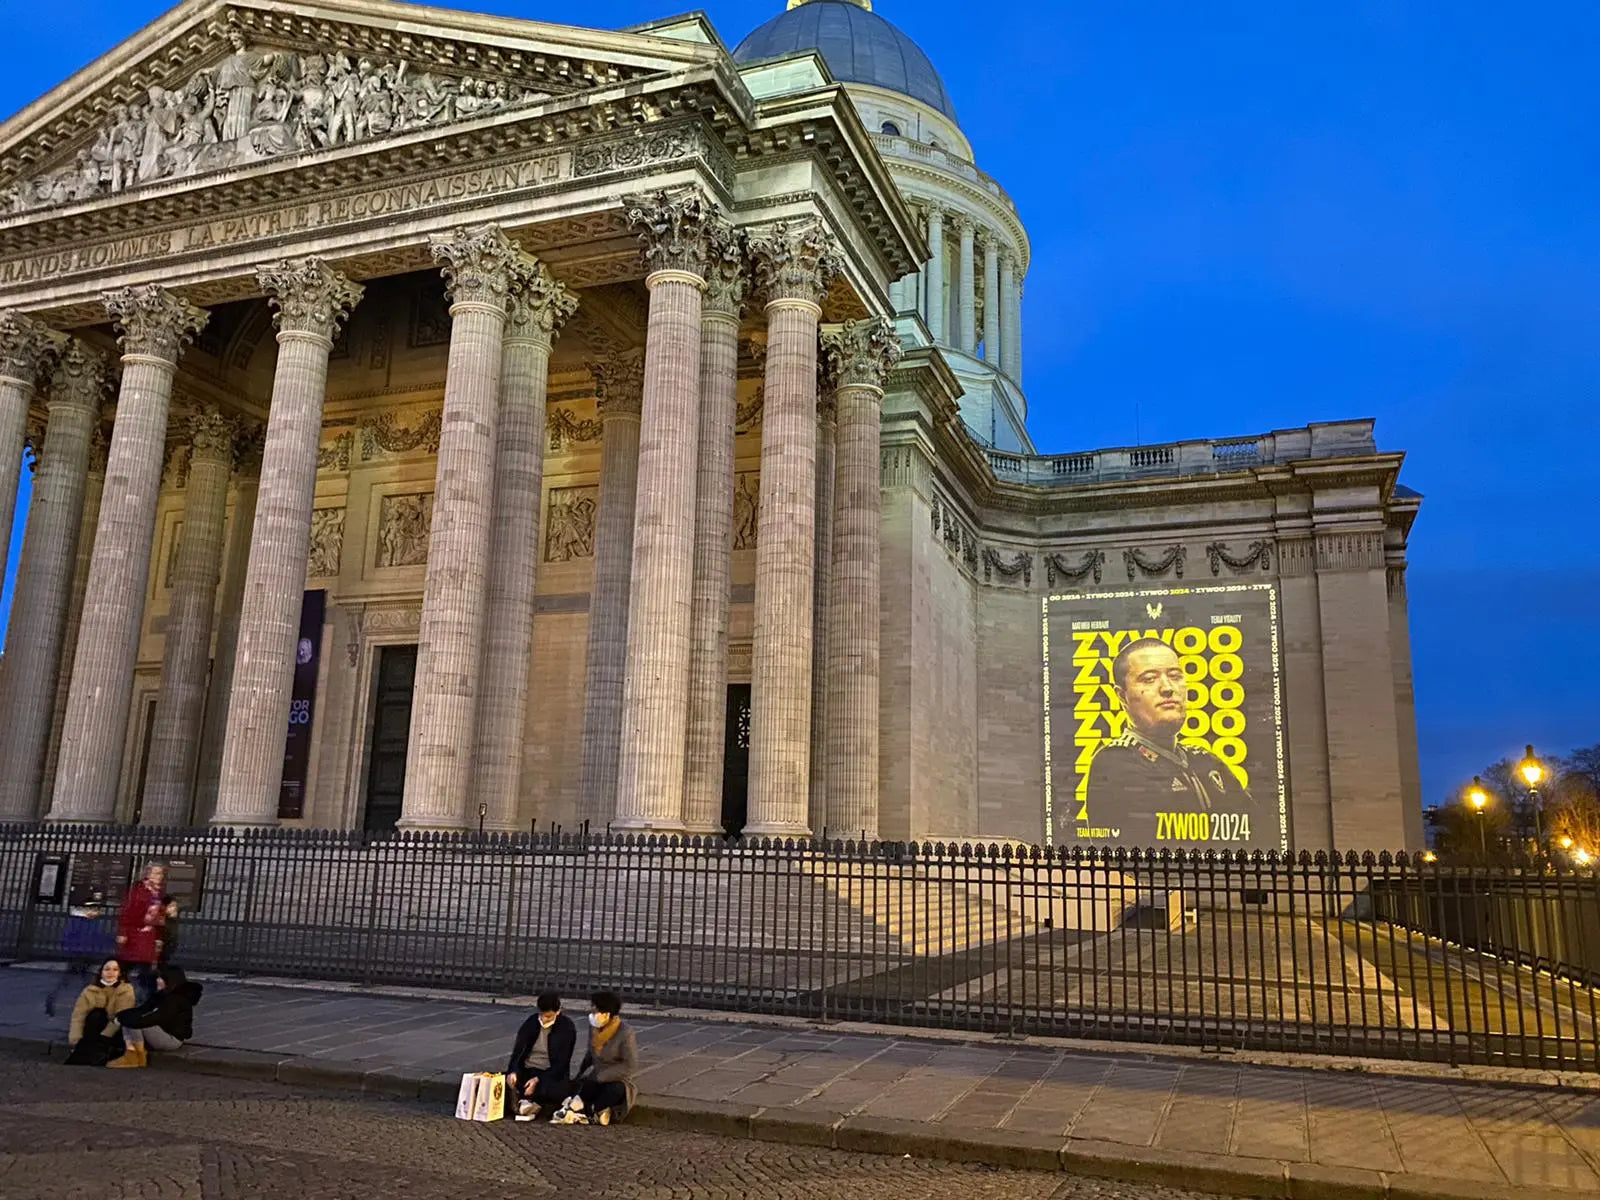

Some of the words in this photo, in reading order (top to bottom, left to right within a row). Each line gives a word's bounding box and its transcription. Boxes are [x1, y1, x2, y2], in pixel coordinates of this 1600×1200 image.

[0, 252, 72, 282] RANDS
[76, 233, 172, 268] HOMMES
[184, 224, 215, 248] LA
[220, 207, 309, 242] PATRIE
[317, 157, 560, 223] RECONNAISSANTE
[1073, 681, 1245, 711] ZYOO
[1074, 709, 1246, 738] ZYOO
[1155, 812, 1210, 841] ZYWOO
[1210, 812, 1251, 841] 2024
